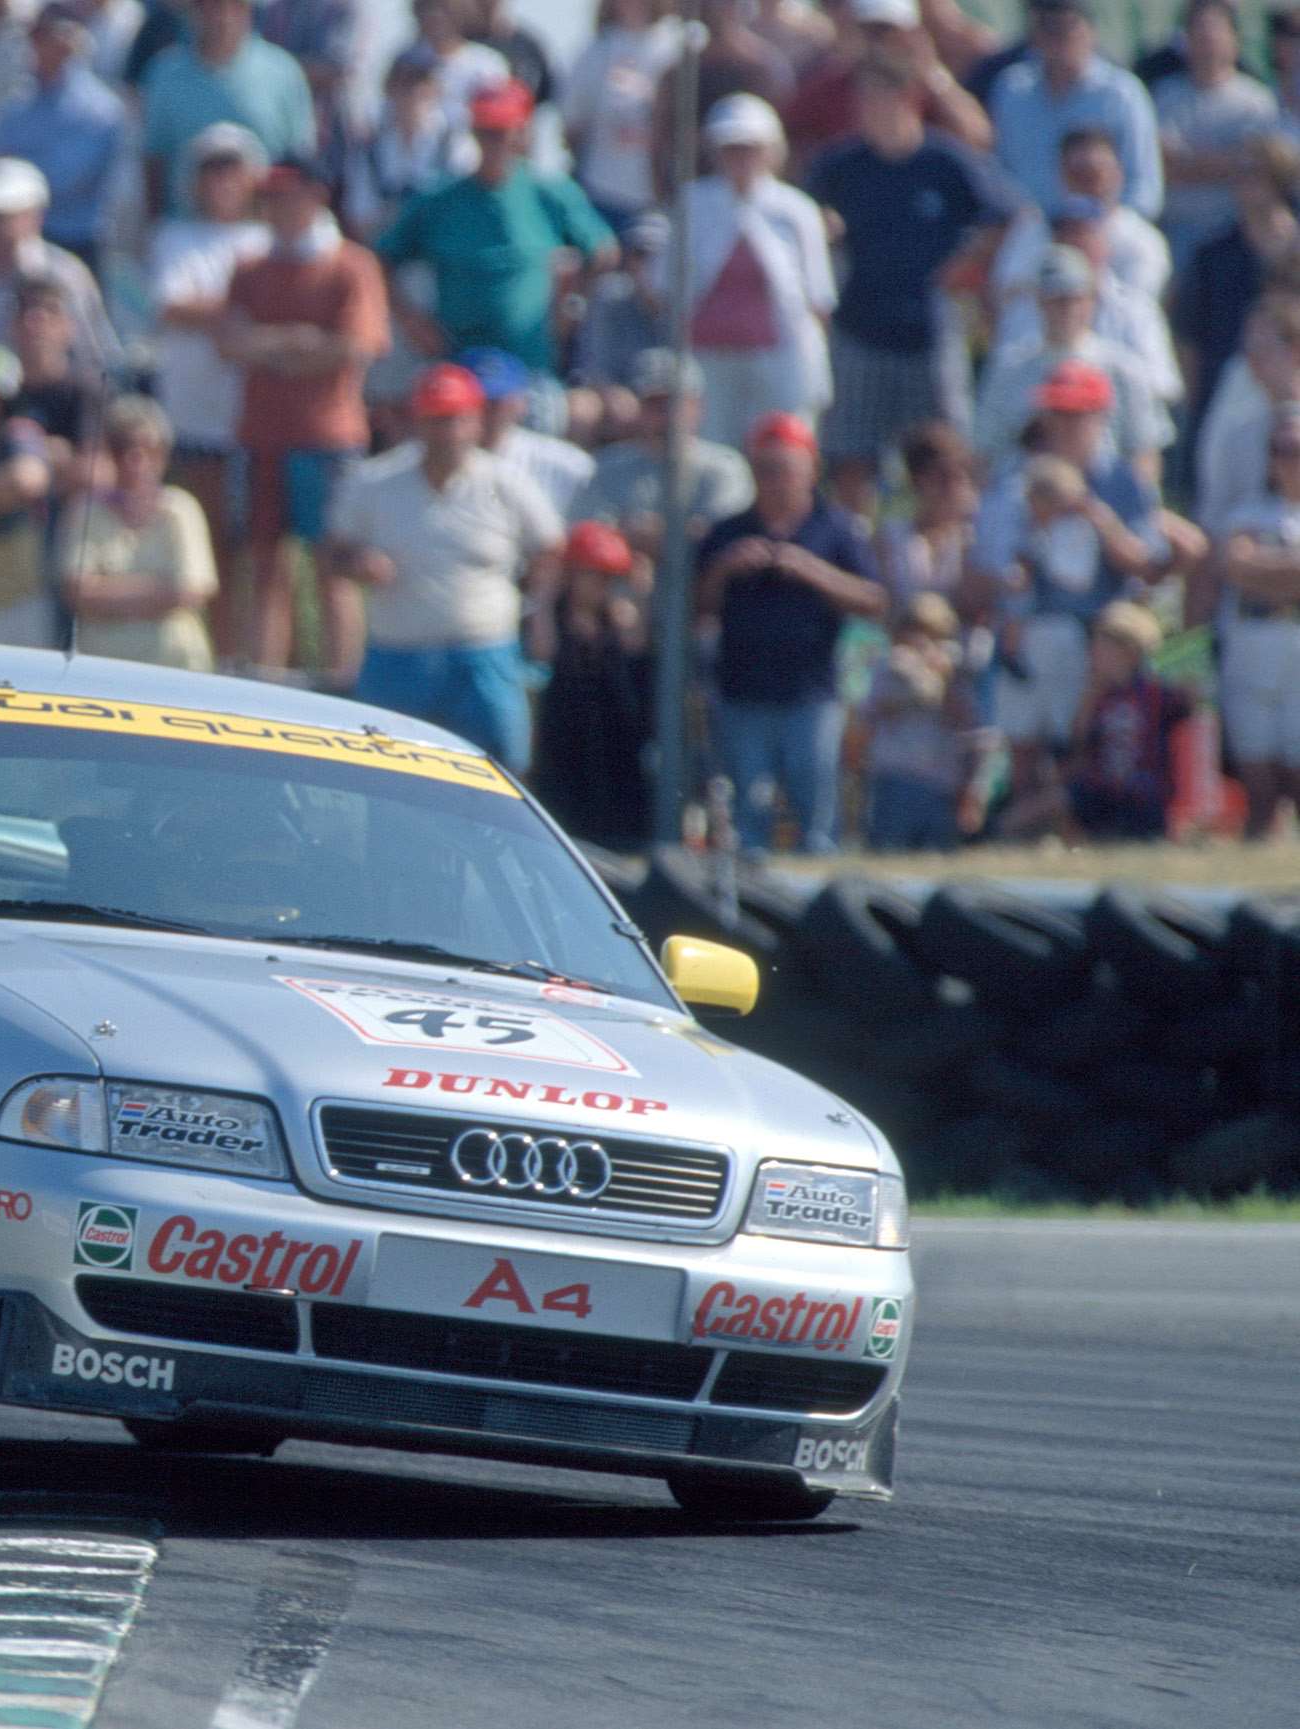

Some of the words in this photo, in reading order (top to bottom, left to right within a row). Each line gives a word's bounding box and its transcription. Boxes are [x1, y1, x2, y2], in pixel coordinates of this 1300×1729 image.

[384, 1008, 537, 1045] 45
[382, 1067, 669, 1116] DUNLOP
[117, 1120, 263, 1152] Trader
[150, 1106, 240, 1131] Auto
[787, 1185, 856, 1206] Auto
[766, 1200, 872, 1228] Trader
[85, 1226, 130, 1245] Castrol
[147, 1214, 362, 1297] Castrol
[463, 1257, 592, 1320] A4
[692, 1280, 864, 1352] Castrol
[51, 1343, 175, 1392] BOSCH
[794, 1437, 869, 1471] BOSCH
